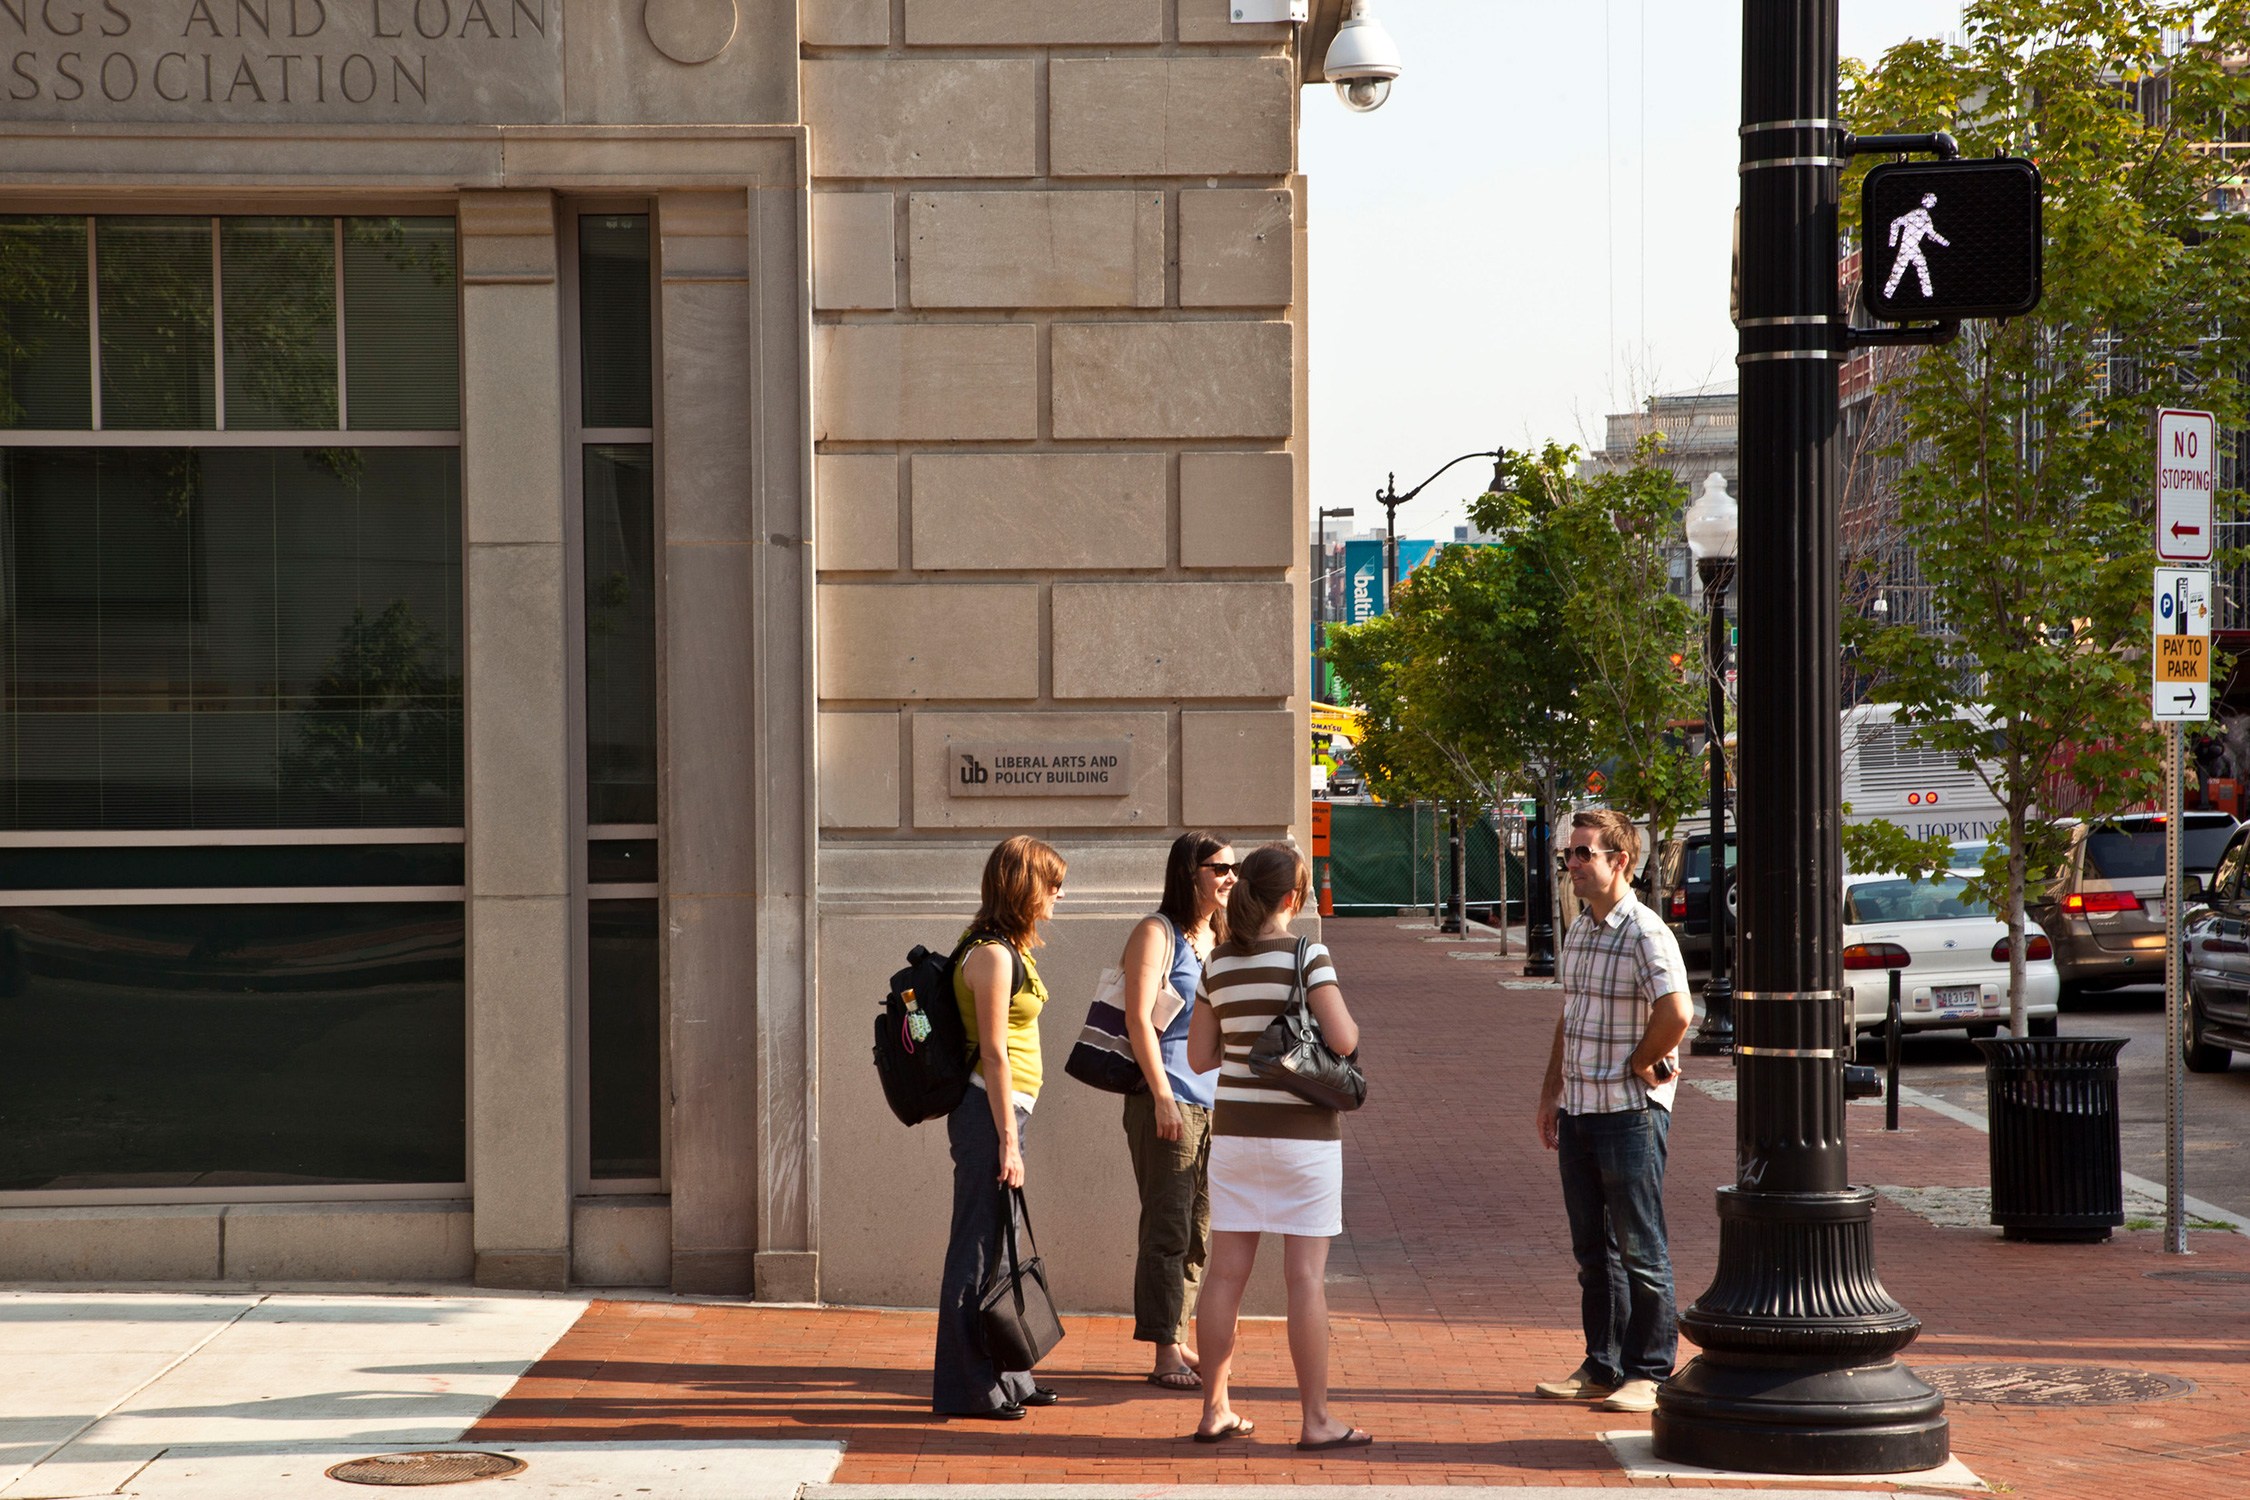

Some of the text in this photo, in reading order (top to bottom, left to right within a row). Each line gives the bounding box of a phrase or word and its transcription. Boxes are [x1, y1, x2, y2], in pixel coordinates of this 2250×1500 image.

[183, 0, 327, 39] AND
[371, 0, 548, 39] LOAN
[6, 51, 428, 104] SSOCIATION
[2174, 431, 2197, 459] NO
[2162, 468, 2210, 491] STOPPING
[2163, 598, 2171, 613] P
[2163, 638, 2202, 656] PAY TO
[2167, 660, 2197, 678] PARK
[1311, 722, 1342, 732] OMATSU
[995, 756, 1118, 768] LIBERAL ARTS AND
[995, 771, 1109, 784] POLICY BUILDING
